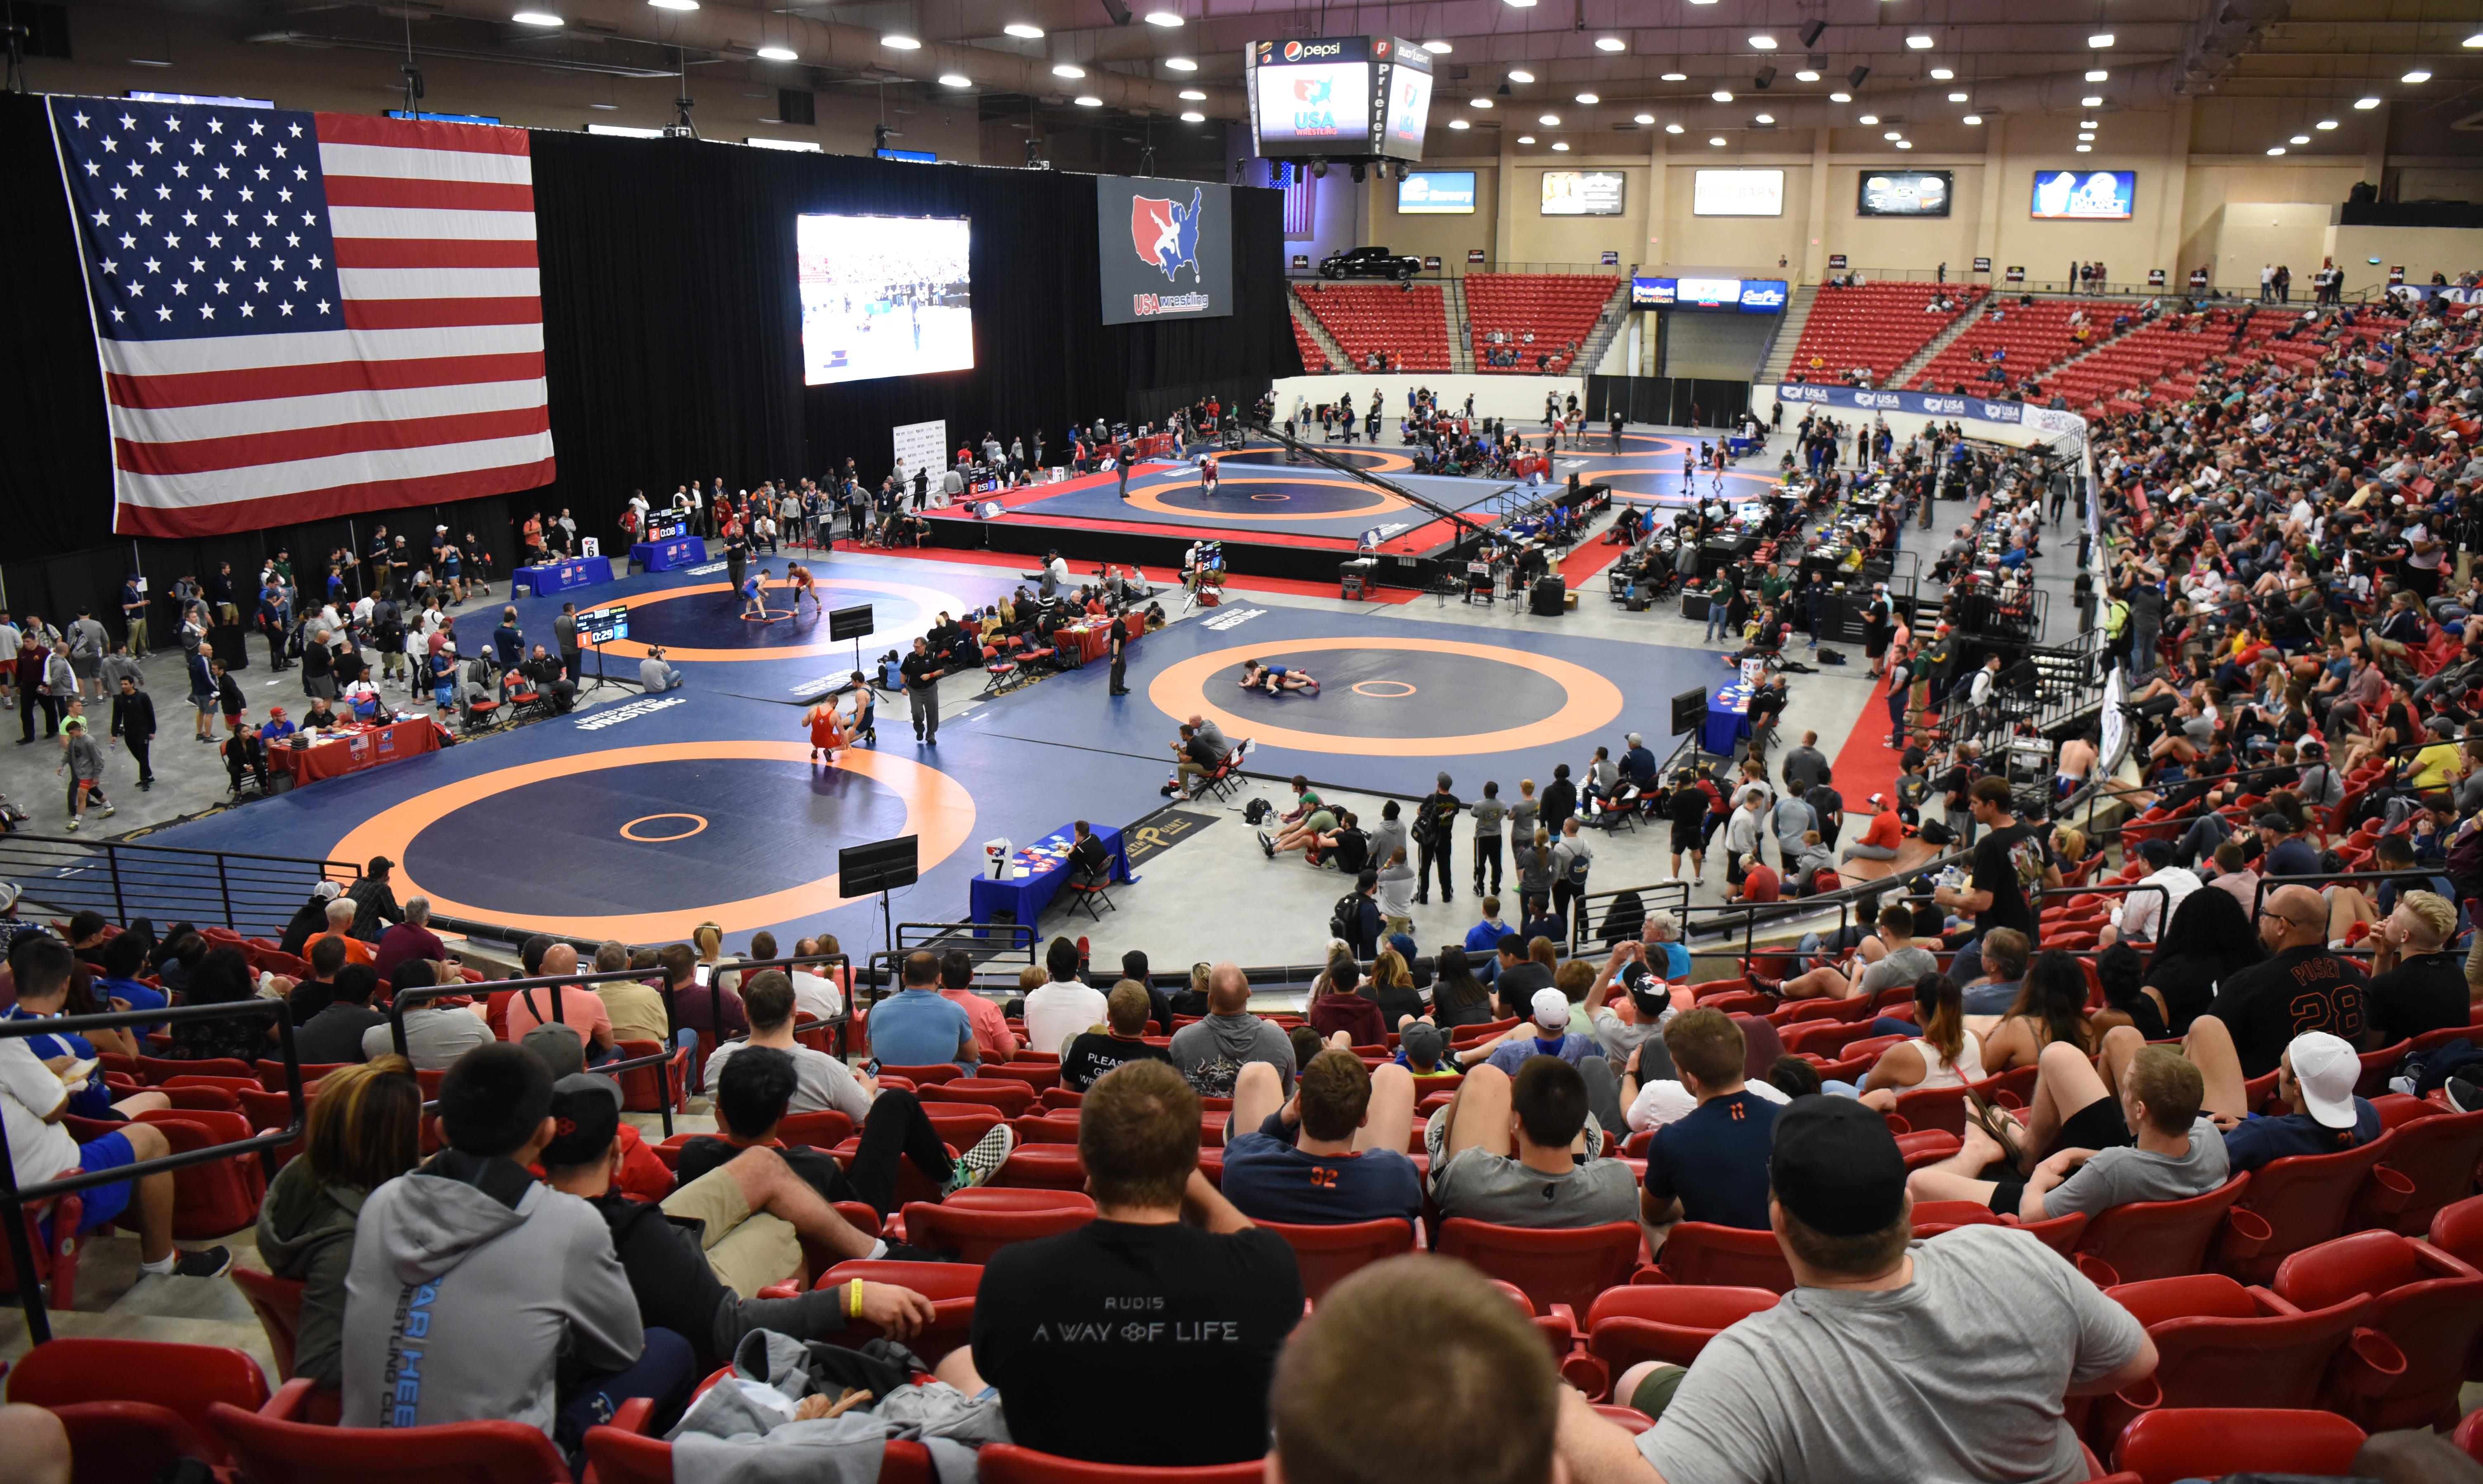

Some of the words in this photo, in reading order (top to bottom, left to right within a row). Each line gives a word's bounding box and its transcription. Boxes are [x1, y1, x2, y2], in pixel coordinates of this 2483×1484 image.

[1304, 43, 1341, 58] pepsi
[1398, 46, 1411, 57] BUD
[1412, 51, 1430, 64] LIGHT
[1373, 64, 1390, 154] Priefert
[1295, 111, 1336, 129] USA
[1134, 293, 1160, 315] USA
[1159, 291, 1208, 309] wrestling
[1633, 295, 1674, 304] Pavilion
[1804, 388, 1829, 398] USA
[1878, 395, 1899, 404] USA
[1944, 399, 1965, 410] USA
[2001, 406, 2020, 417] USA
[652, 531, 657, 539] 2
[660, 527, 676, 537] 0:08
[678, 525, 684, 534] 3
[588, 546, 594, 557] 6
[1208, 609, 1267, 631] WRESTLING
[582, 634, 587, 645] 1
[592, 629, 613, 642] 0:29
[617, 626, 624, 637] 2
[789, 679, 825, 691] UNITED
[819, 669, 856, 681] WORLD
[574, 710, 618, 724] UNITED
[617, 698, 657, 711] WORLD
[576, 697, 686, 730] WRESTLING
[378, 742, 393, 751] USA
[1135, 818, 1185, 846] POINT
[991, 859, 1004, 879] 7
[2290, 984, 2365, 1039] 28
[1088, 1053, 1124, 1068] PLEAS
[1729, 1102, 1745, 1120] 11
[1310, 1166, 1338, 1188] 32
[1541, 1182, 1555, 1201] 4
[402, 1278, 442, 1339] AR
[1105, 1297, 1166, 1310] RUDIS
[382, 1283, 415, 1384] RESTLING
[1032, 1323, 1050, 1342] A
[1058, 1323, 1113, 1342] WAY
[1176, 1321, 1240, 1341] LIFE
[393, 1350, 424, 1428] HEE
